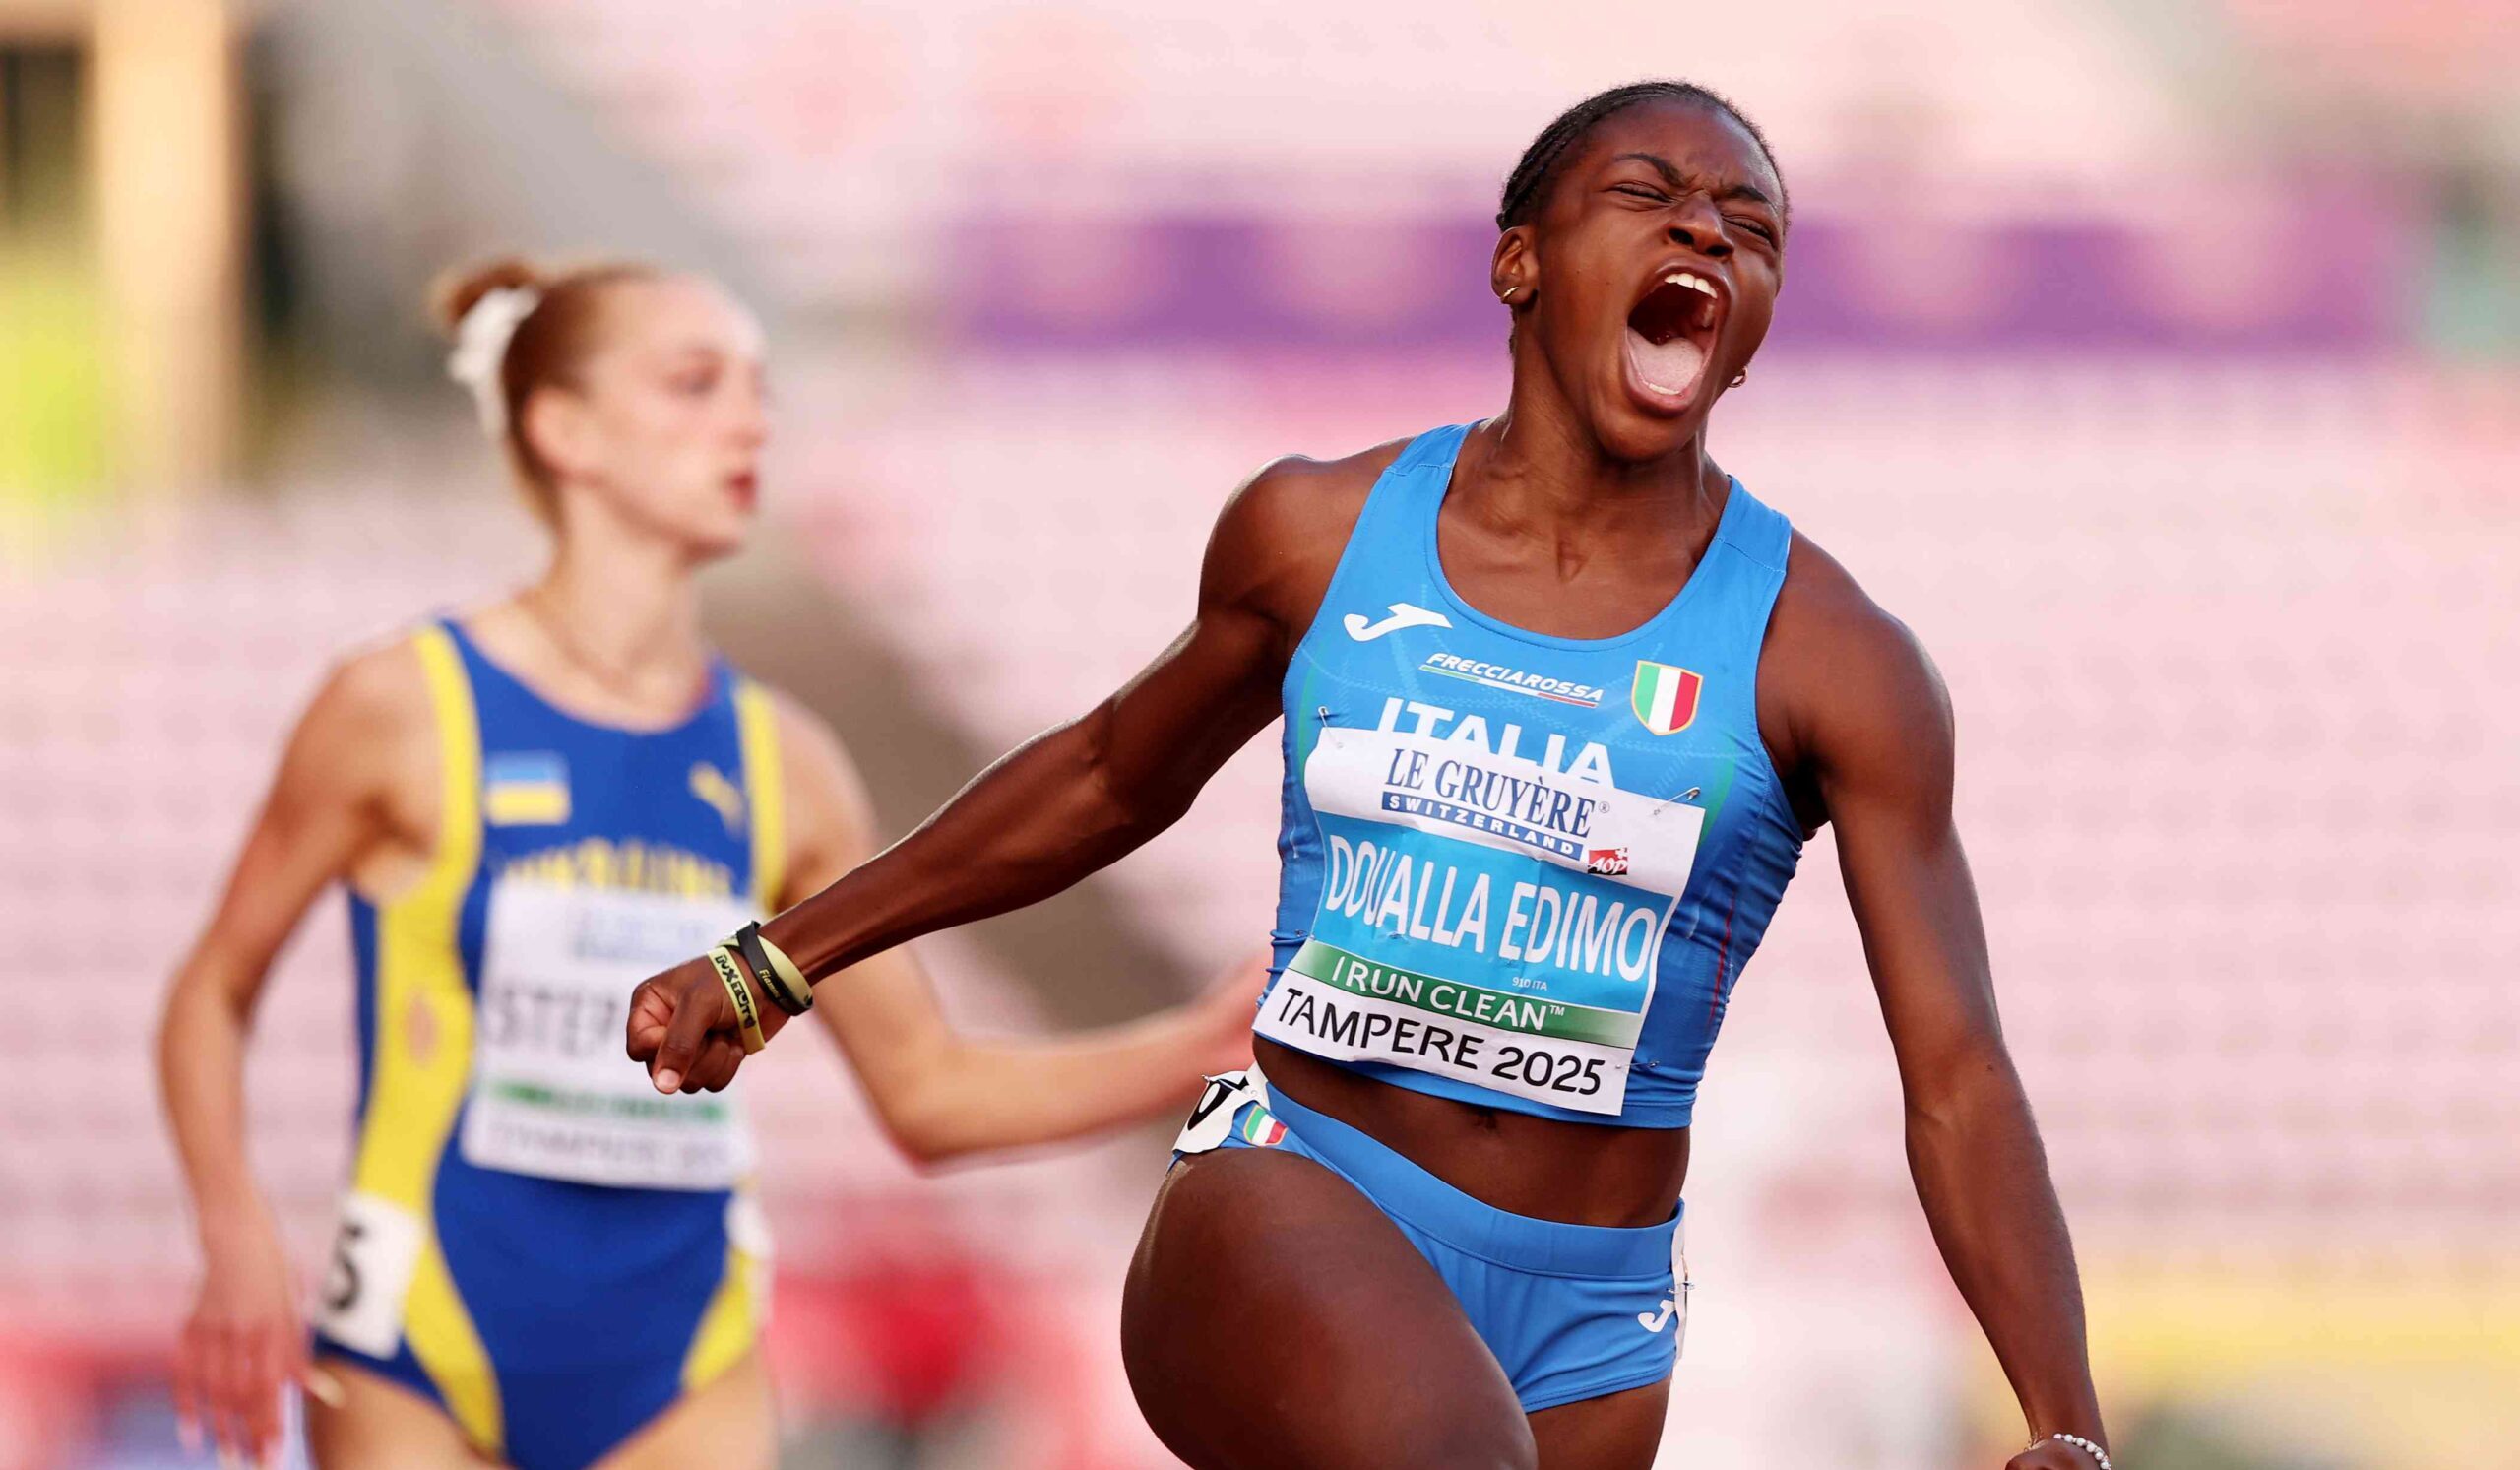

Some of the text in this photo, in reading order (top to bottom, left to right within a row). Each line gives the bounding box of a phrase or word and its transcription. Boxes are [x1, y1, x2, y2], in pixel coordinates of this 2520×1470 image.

[1425, 652, 1605, 702] FRECCIAROSSA
[1375, 695, 1615, 790] ITALIA
[1385, 747, 1429, 791] LE
[1388, 794, 1576, 857] SWITZERLAND
[1587, 856, 1629, 875] AOP
[1325, 834, 1658, 983] DOUALLA EDIMO
[1331, 955, 1347, 983] I
[1346, 962, 1424, 1003] RUN
[1532, 979, 1548, 991] ITA
[1279, 987, 1606, 1096] TAMPERE 2025
